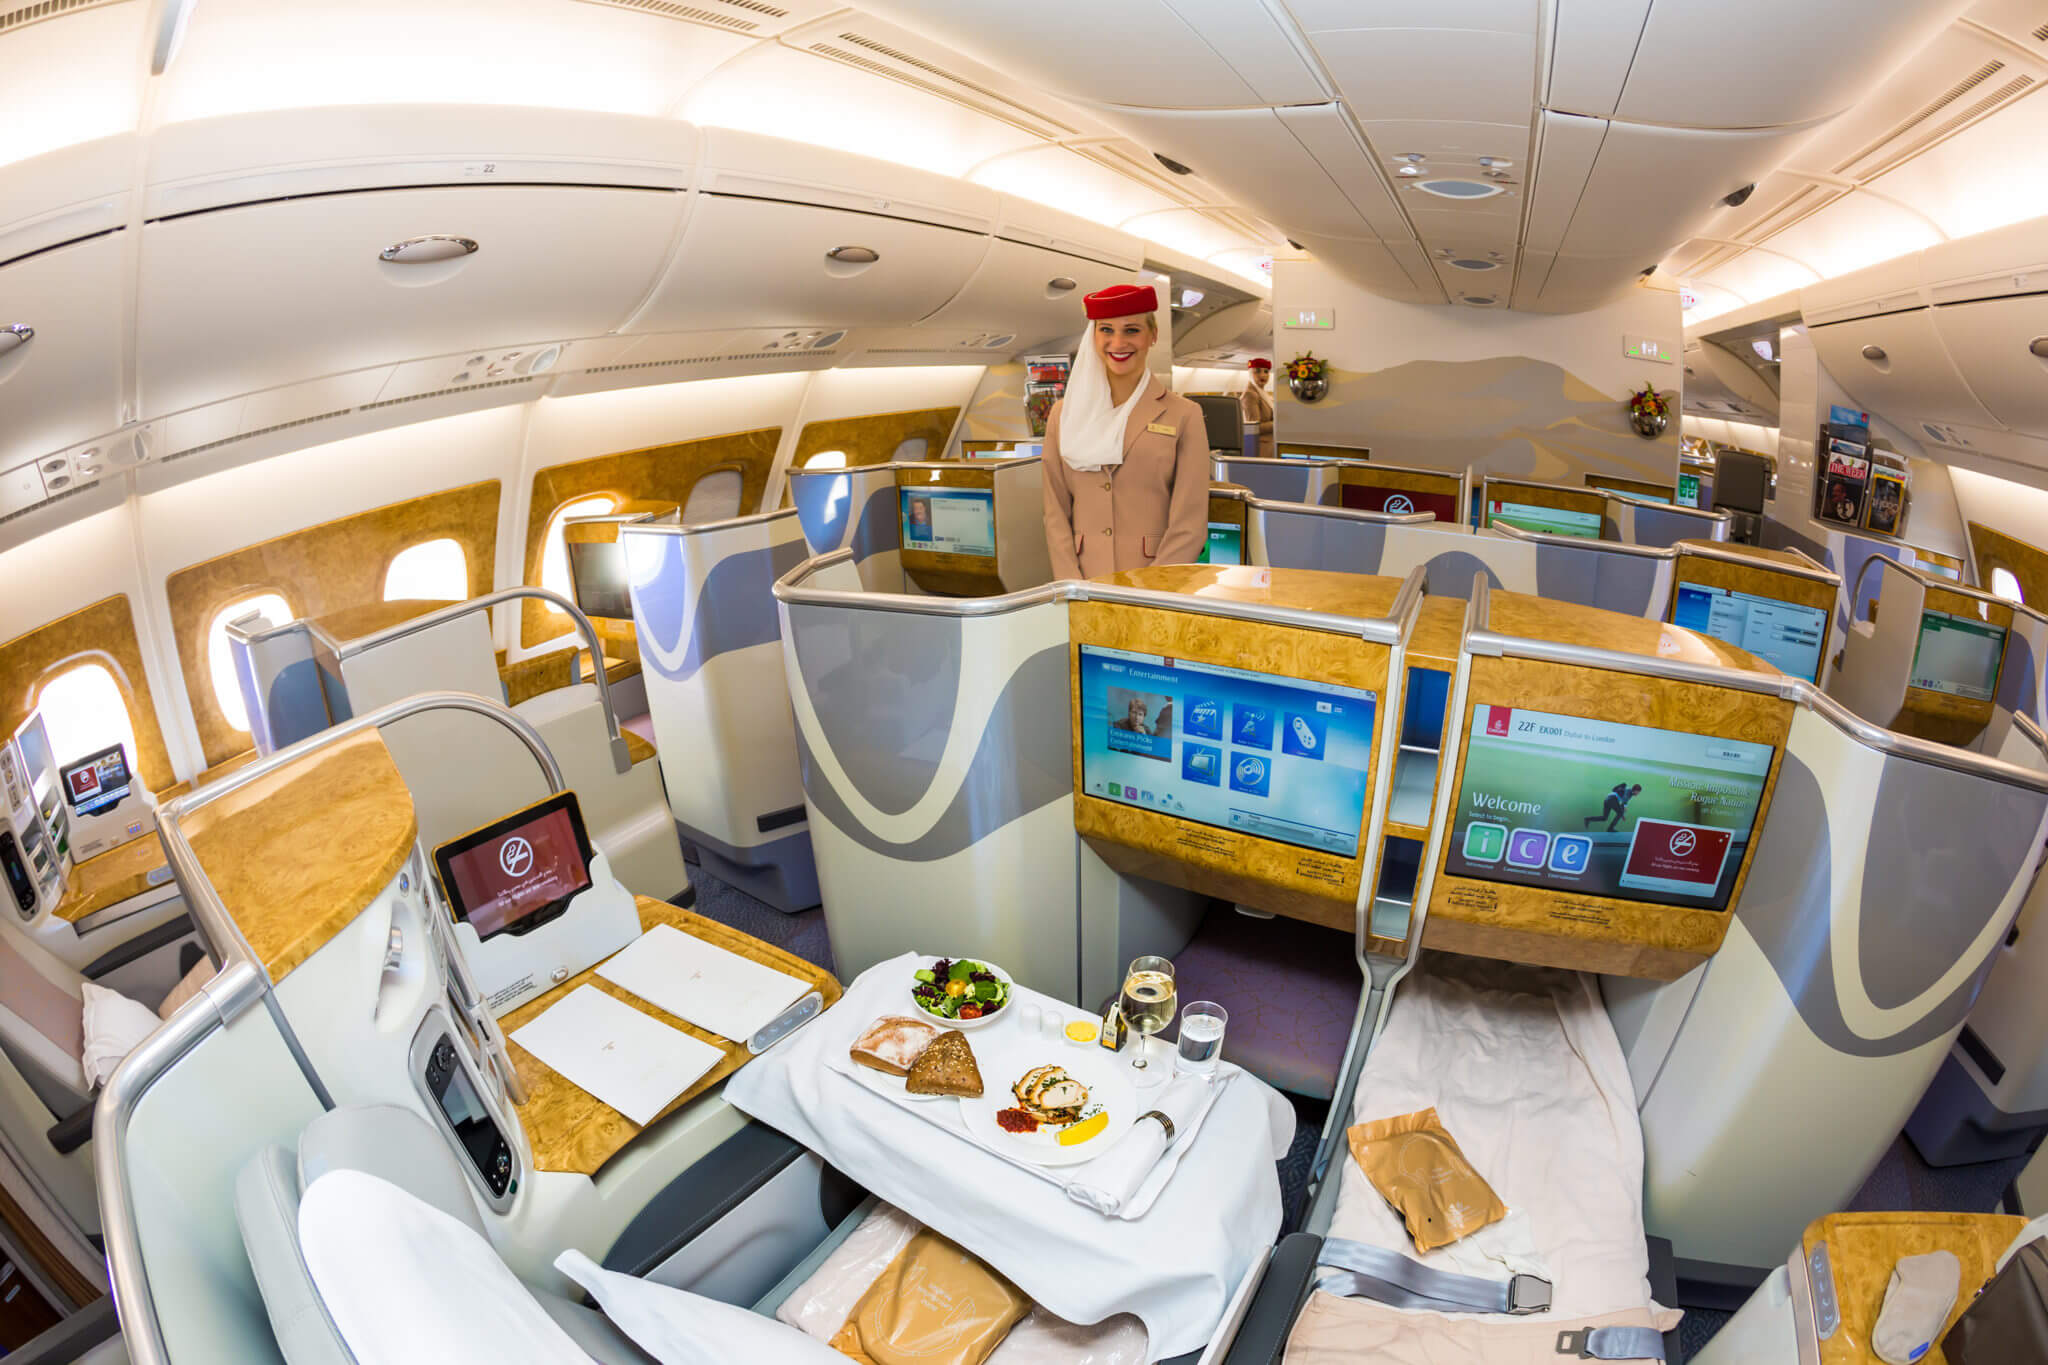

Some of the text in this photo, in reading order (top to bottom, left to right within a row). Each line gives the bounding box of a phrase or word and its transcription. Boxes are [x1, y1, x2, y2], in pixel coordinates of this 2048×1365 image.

[483, 163, 496, 174] 22
[1129, 668, 1179, 684] Entertainment
[1518, 720, 1537, 732] 22F
[1539, 726, 1562, 736] EK001
[1472, 791, 1541, 815] Welcome
[1480, 831, 1490, 853] i
[1561, 844, 1579, 865] e
